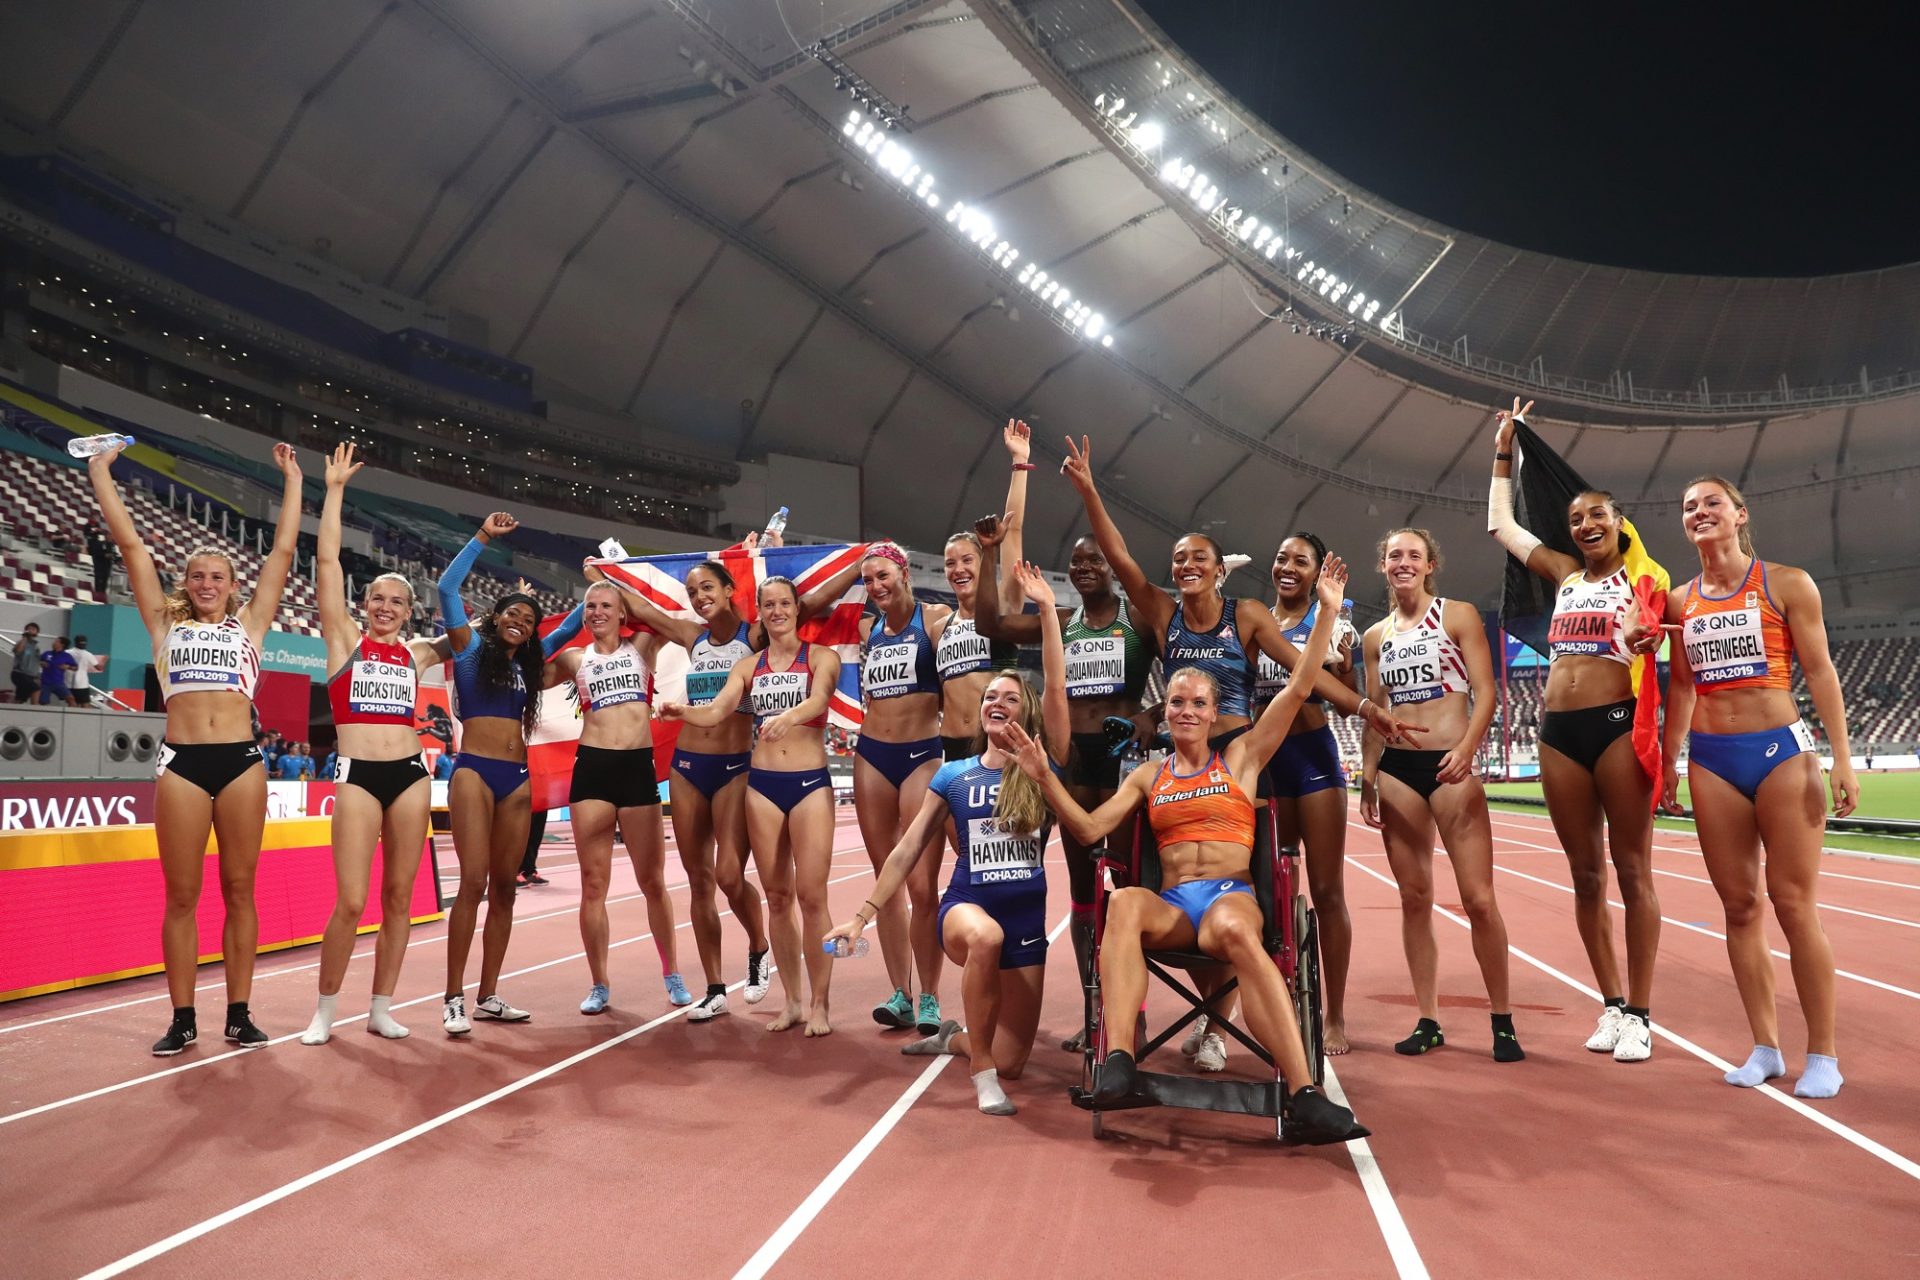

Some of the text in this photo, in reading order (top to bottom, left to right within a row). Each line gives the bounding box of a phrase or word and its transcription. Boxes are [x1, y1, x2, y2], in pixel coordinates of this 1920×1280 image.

[1552, 616, 1607, 637] THIAM
[1709, 613, 1748, 630] QNB
[198, 630, 232, 643] QNB
[884, 645, 909, 659] QNB
[937, 638, 988, 667] VORONINA
[1083, 640, 1115, 653] QNB
[1176, 647, 1225, 659] FRANCE
[1398, 643, 1428, 659] QNB
[1686, 634, 1762, 666] OOSTERWEGEL
[170, 647, 238, 668] MAUDENS
[605, 659, 633, 671] QNB
[706, 659, 733, 670] QNB
[179, 670, 229, 682] DOHA2019
[378, 665, 408, 678] QNB
[868, 662, 909, 685] KUNZ
[1381, 663, 1435, 687] VIDTS
[1512, 669, 1536, 678] IAAF
[588, 673, 641, 698] PREINER
[771, 674, 799, 686] QNB
[352, 680, 413, 703] RUCKSTUHL
[872, 685, 908, 698] DOHA2019
[1071, 684, 1114, 697] DOHA2019
[598, 693, 639, 708] DOHA2019
[359, 702, 406, 715] DOHA2019
[335, 762, 342, 779] 5
[968, 784, 1001, 808] US
[2, 795, 137, 831] RWAYS
[972, 839, 1037, 865] HAWKINS
[982, 869, 1032, 882] DOHA2019
